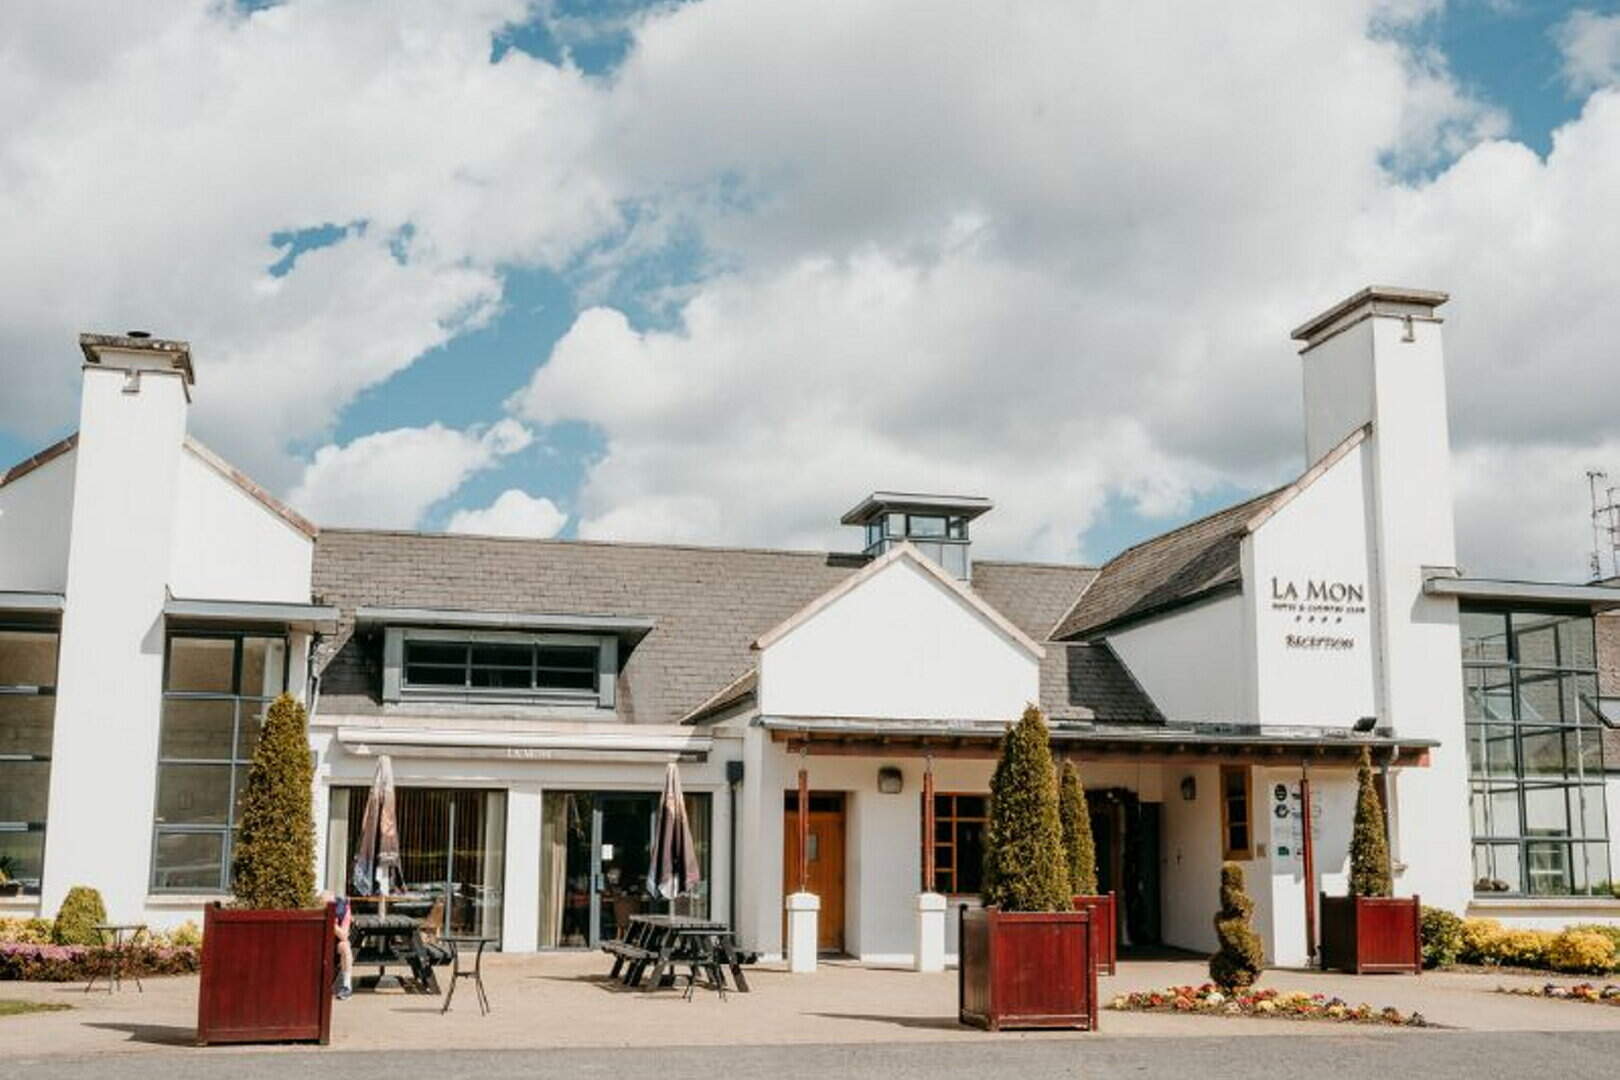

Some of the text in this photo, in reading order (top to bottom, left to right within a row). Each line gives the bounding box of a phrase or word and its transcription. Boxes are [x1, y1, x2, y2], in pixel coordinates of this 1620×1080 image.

[1272, 576, 1363, 602] LA MON
[1286, 634, 1354, 649] RECEPTION
